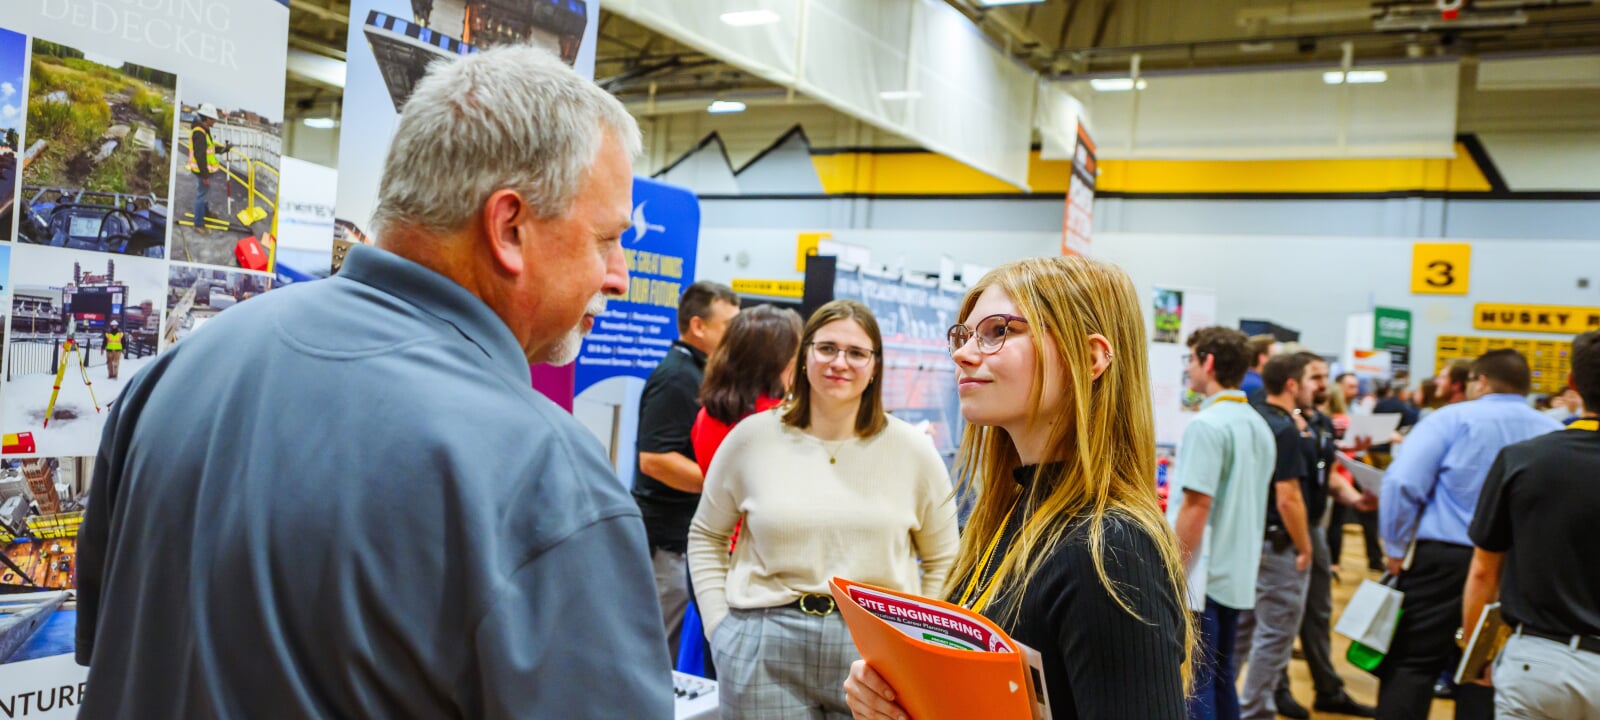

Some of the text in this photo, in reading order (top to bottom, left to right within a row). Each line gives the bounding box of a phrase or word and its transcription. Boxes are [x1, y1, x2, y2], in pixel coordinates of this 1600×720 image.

[1425, 260, 1455, 288] 3
[1481, 311, 1570, 326] HUSKY
[858, 597, 983, 640] SITE ENGINEERING
[923, 622, 949, 636] Planning
